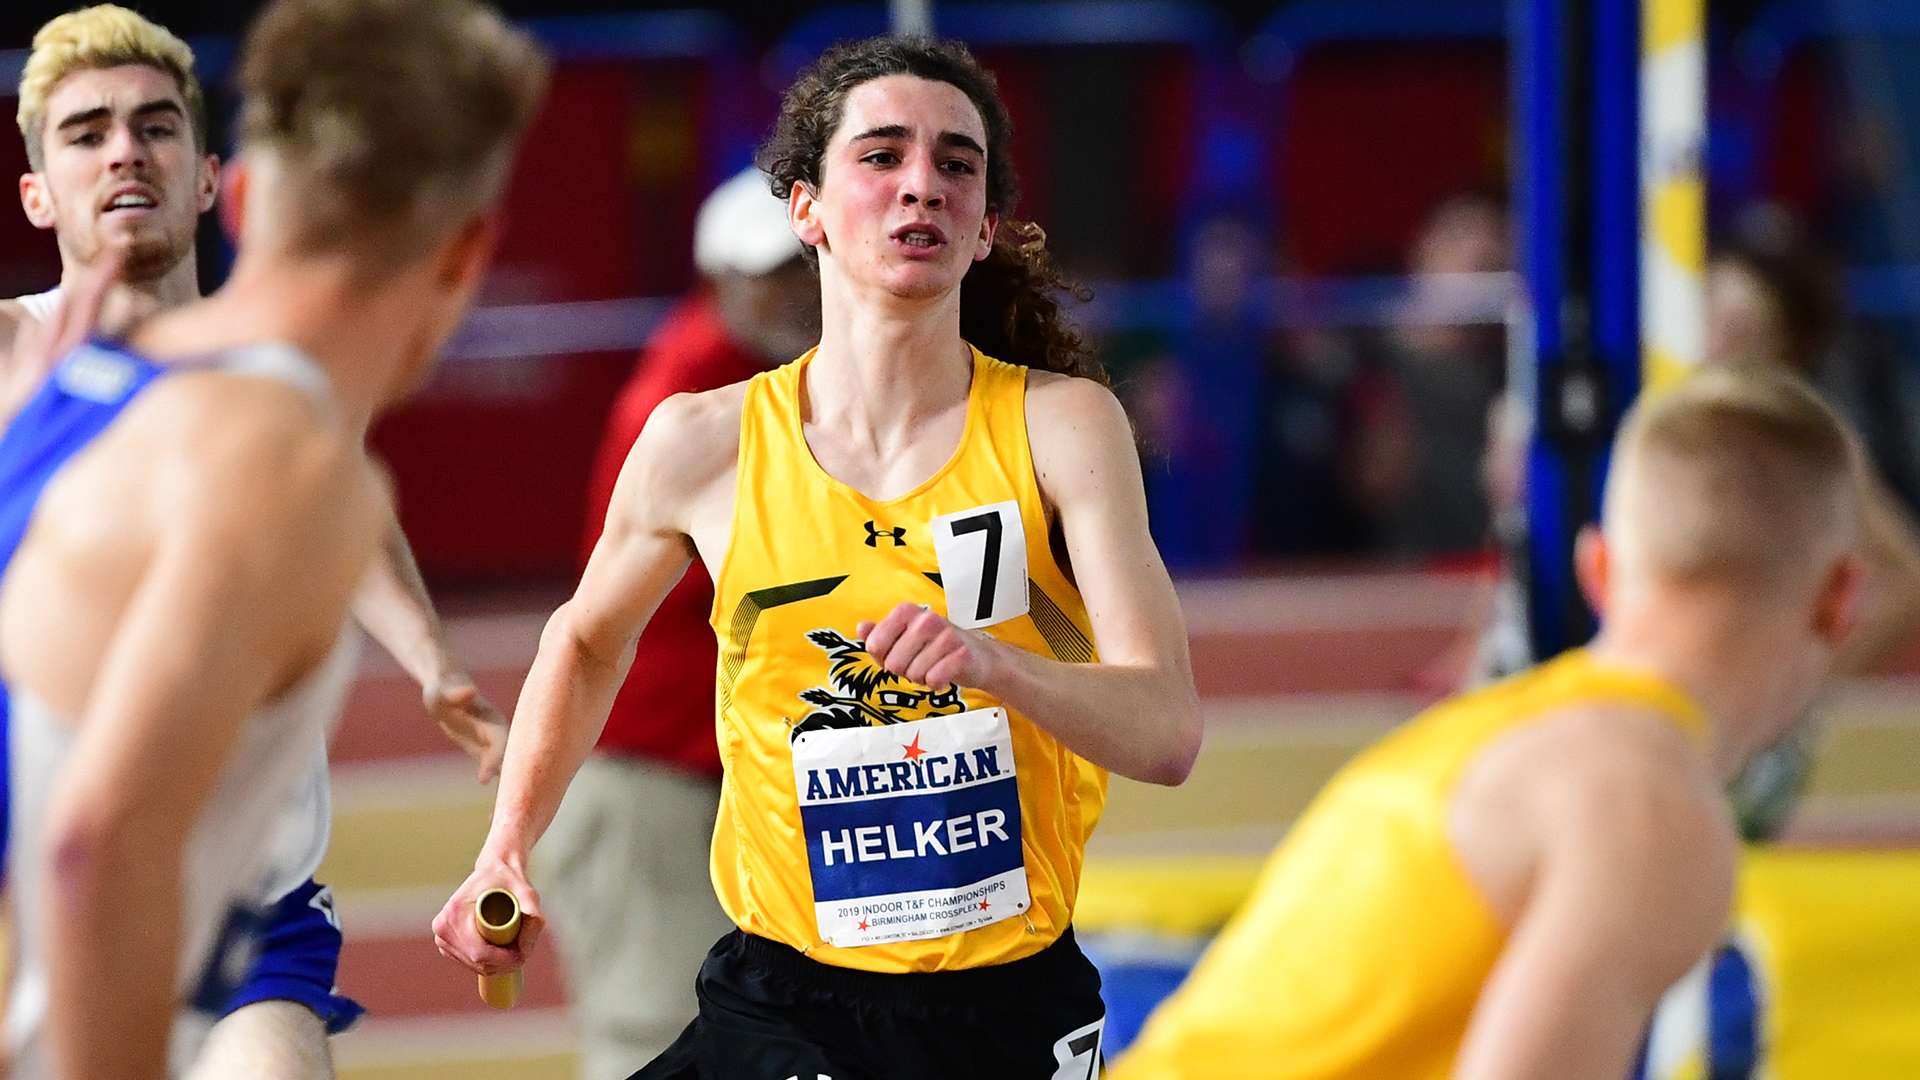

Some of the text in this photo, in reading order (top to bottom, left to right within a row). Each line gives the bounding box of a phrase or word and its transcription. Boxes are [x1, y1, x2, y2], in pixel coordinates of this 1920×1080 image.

[950, 511, 1003, 621] 7
[806, 745, 1001, 801] AMERICAN
[821, 808, 1010, 866] HELKER
[837, 880, 1006, 918] 2019 INDOOR T&F CHAMPIONSHIPS
[872, 912, 928, 927] BIRMINGHAM
[929, 903, 978, 920] CROSSPLEX
